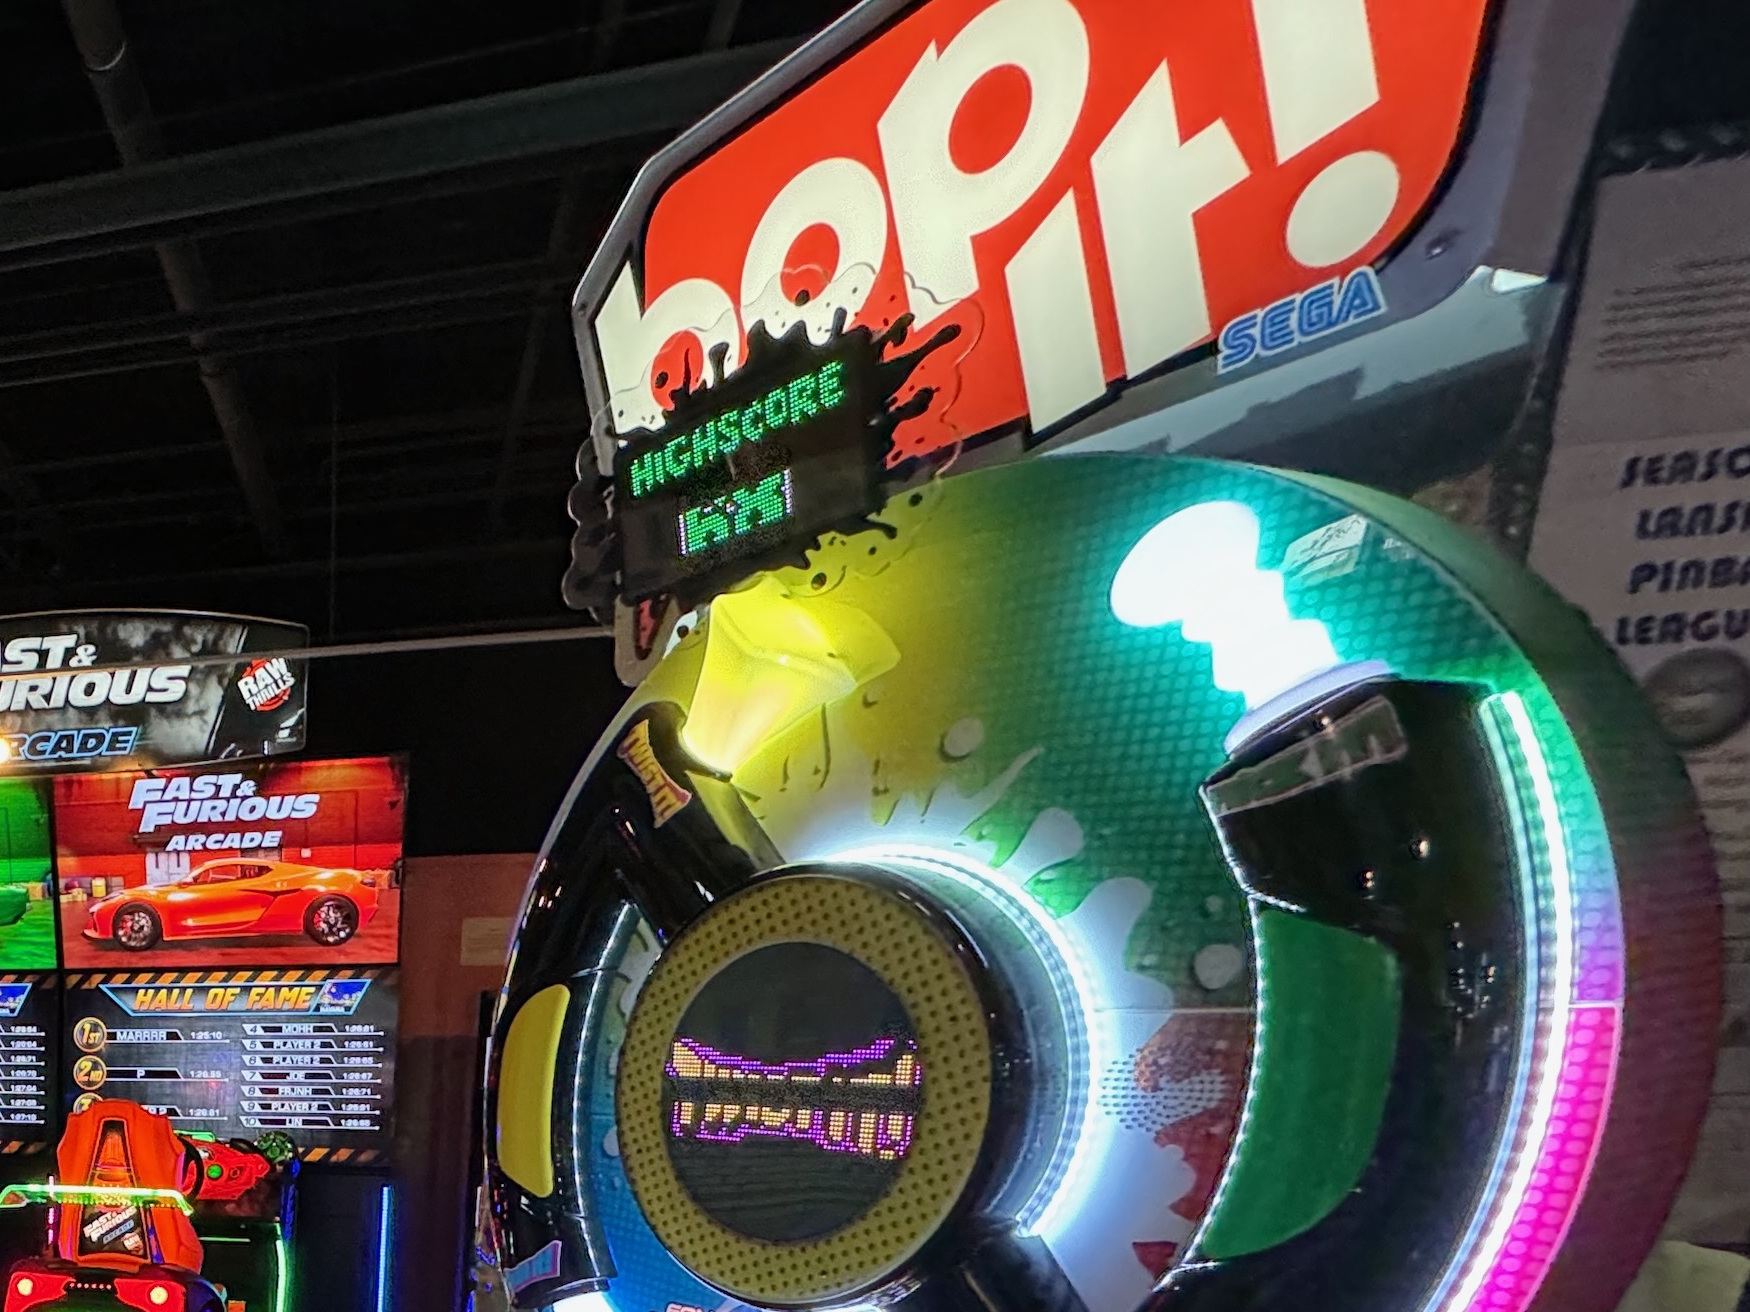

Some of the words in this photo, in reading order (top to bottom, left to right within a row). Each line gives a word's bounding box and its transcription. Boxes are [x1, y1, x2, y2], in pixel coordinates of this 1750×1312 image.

[1218, 267, 1387, 375] SEGA
[629, 360, 846, 498] HIGHSCORE
[237, 657, 289, 697] RAW
[246, 671, 296, 711] THRILLS
[128, 773, 243, 810] FAST
[139, 793, 321, 834] FURIOUS
[165, 830, 283, 852] ARCADE
[132, 987, 195, 1011] HALL
[203, 987, 241, 1010] OF
[245, 985, 317, 1010] FAME
[273, 1040, 309, 1050] PLAYER
[273, 1056, 309, 1066] PLAYER
[244, 1117, 256, 1127] 10
[271, 1102, 306, 1112] PLAYER
